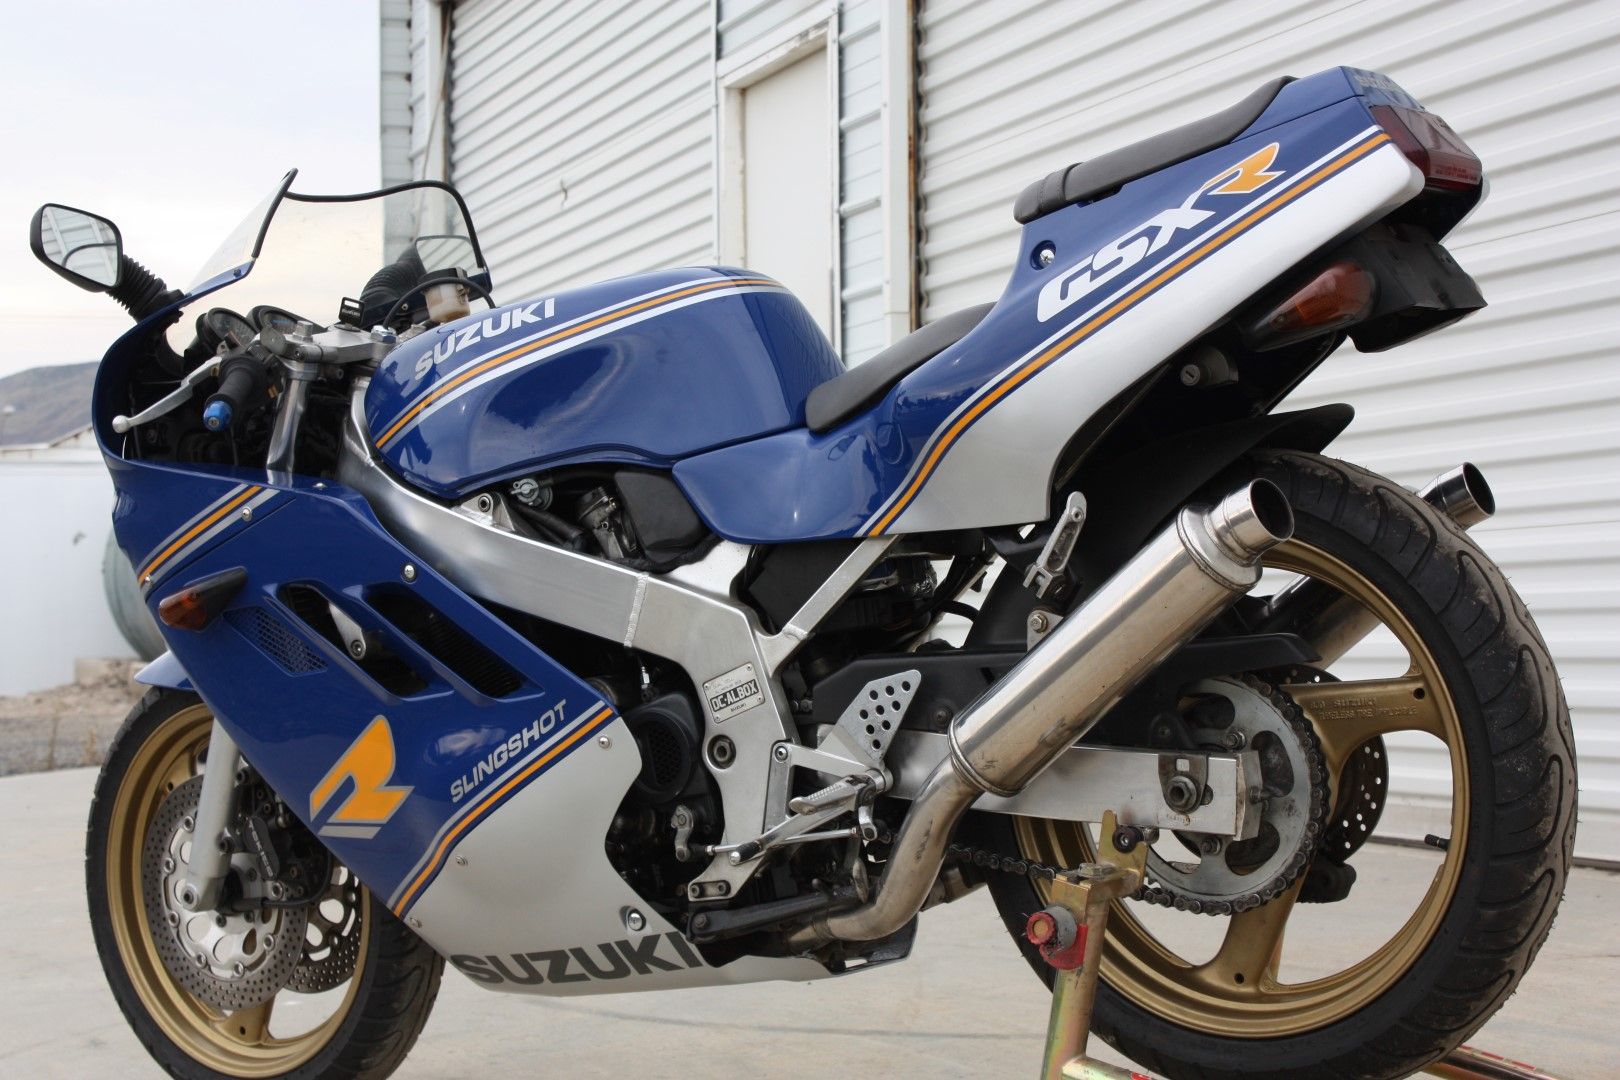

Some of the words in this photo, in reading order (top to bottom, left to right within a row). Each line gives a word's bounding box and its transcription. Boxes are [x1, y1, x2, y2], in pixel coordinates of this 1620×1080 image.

[414, 298, 555, 380] SUZUKI
[450, 699, 567, 803] SLINGSHOT
[450, 931, 703, 985] SUZUKI
